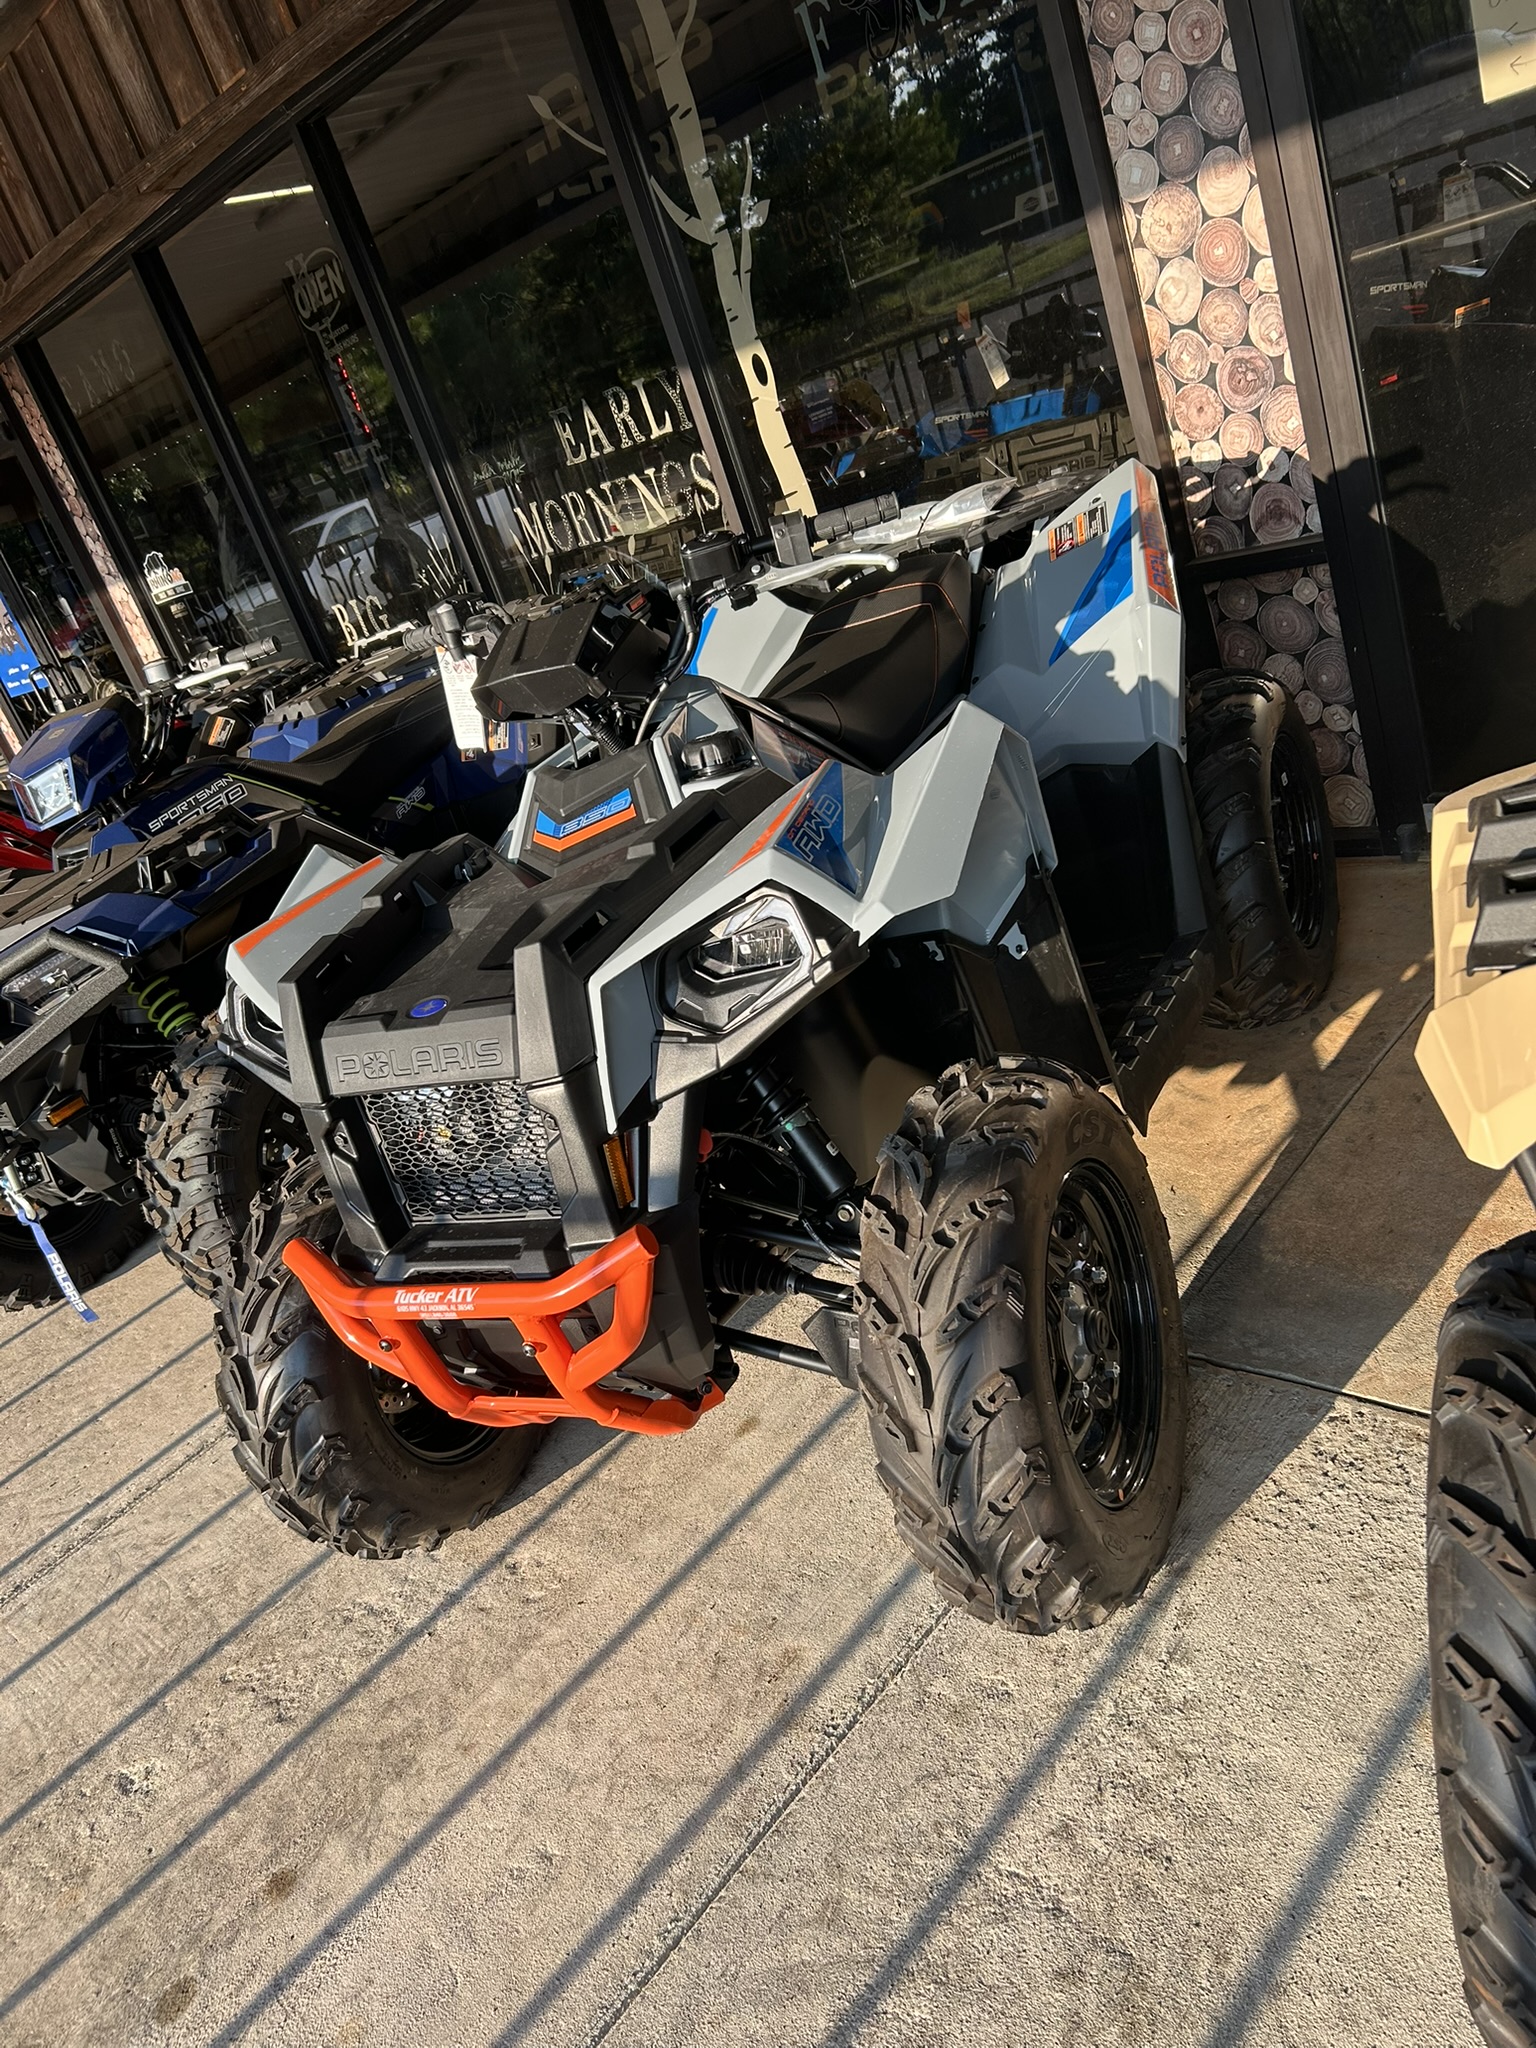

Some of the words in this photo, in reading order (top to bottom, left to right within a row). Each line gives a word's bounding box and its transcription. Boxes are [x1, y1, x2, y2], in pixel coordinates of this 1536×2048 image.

[1369, 280, 1429, 296] SPORTSMAN
[548, 365, 694, 467] EARLY
[934, 410, 990, 425] SPORTSMAN
[513, 449, 721, 559] MORNINGS
[330, 594, 391, 647] BIG
[148, 775, 234, 833] SPORTSMAN
[559, 796, 631, 838] 850
[792, 794, 842, 862] AWD
[336, 1038, 504, 1083] POLARIS
[1065, 1107, 1119, 1156] CST
[46, 1252, 88, 1313] POLARIS
[394, 1289, 444, 1305] Tucker
[444, 1286, 481, 1303] ATV
